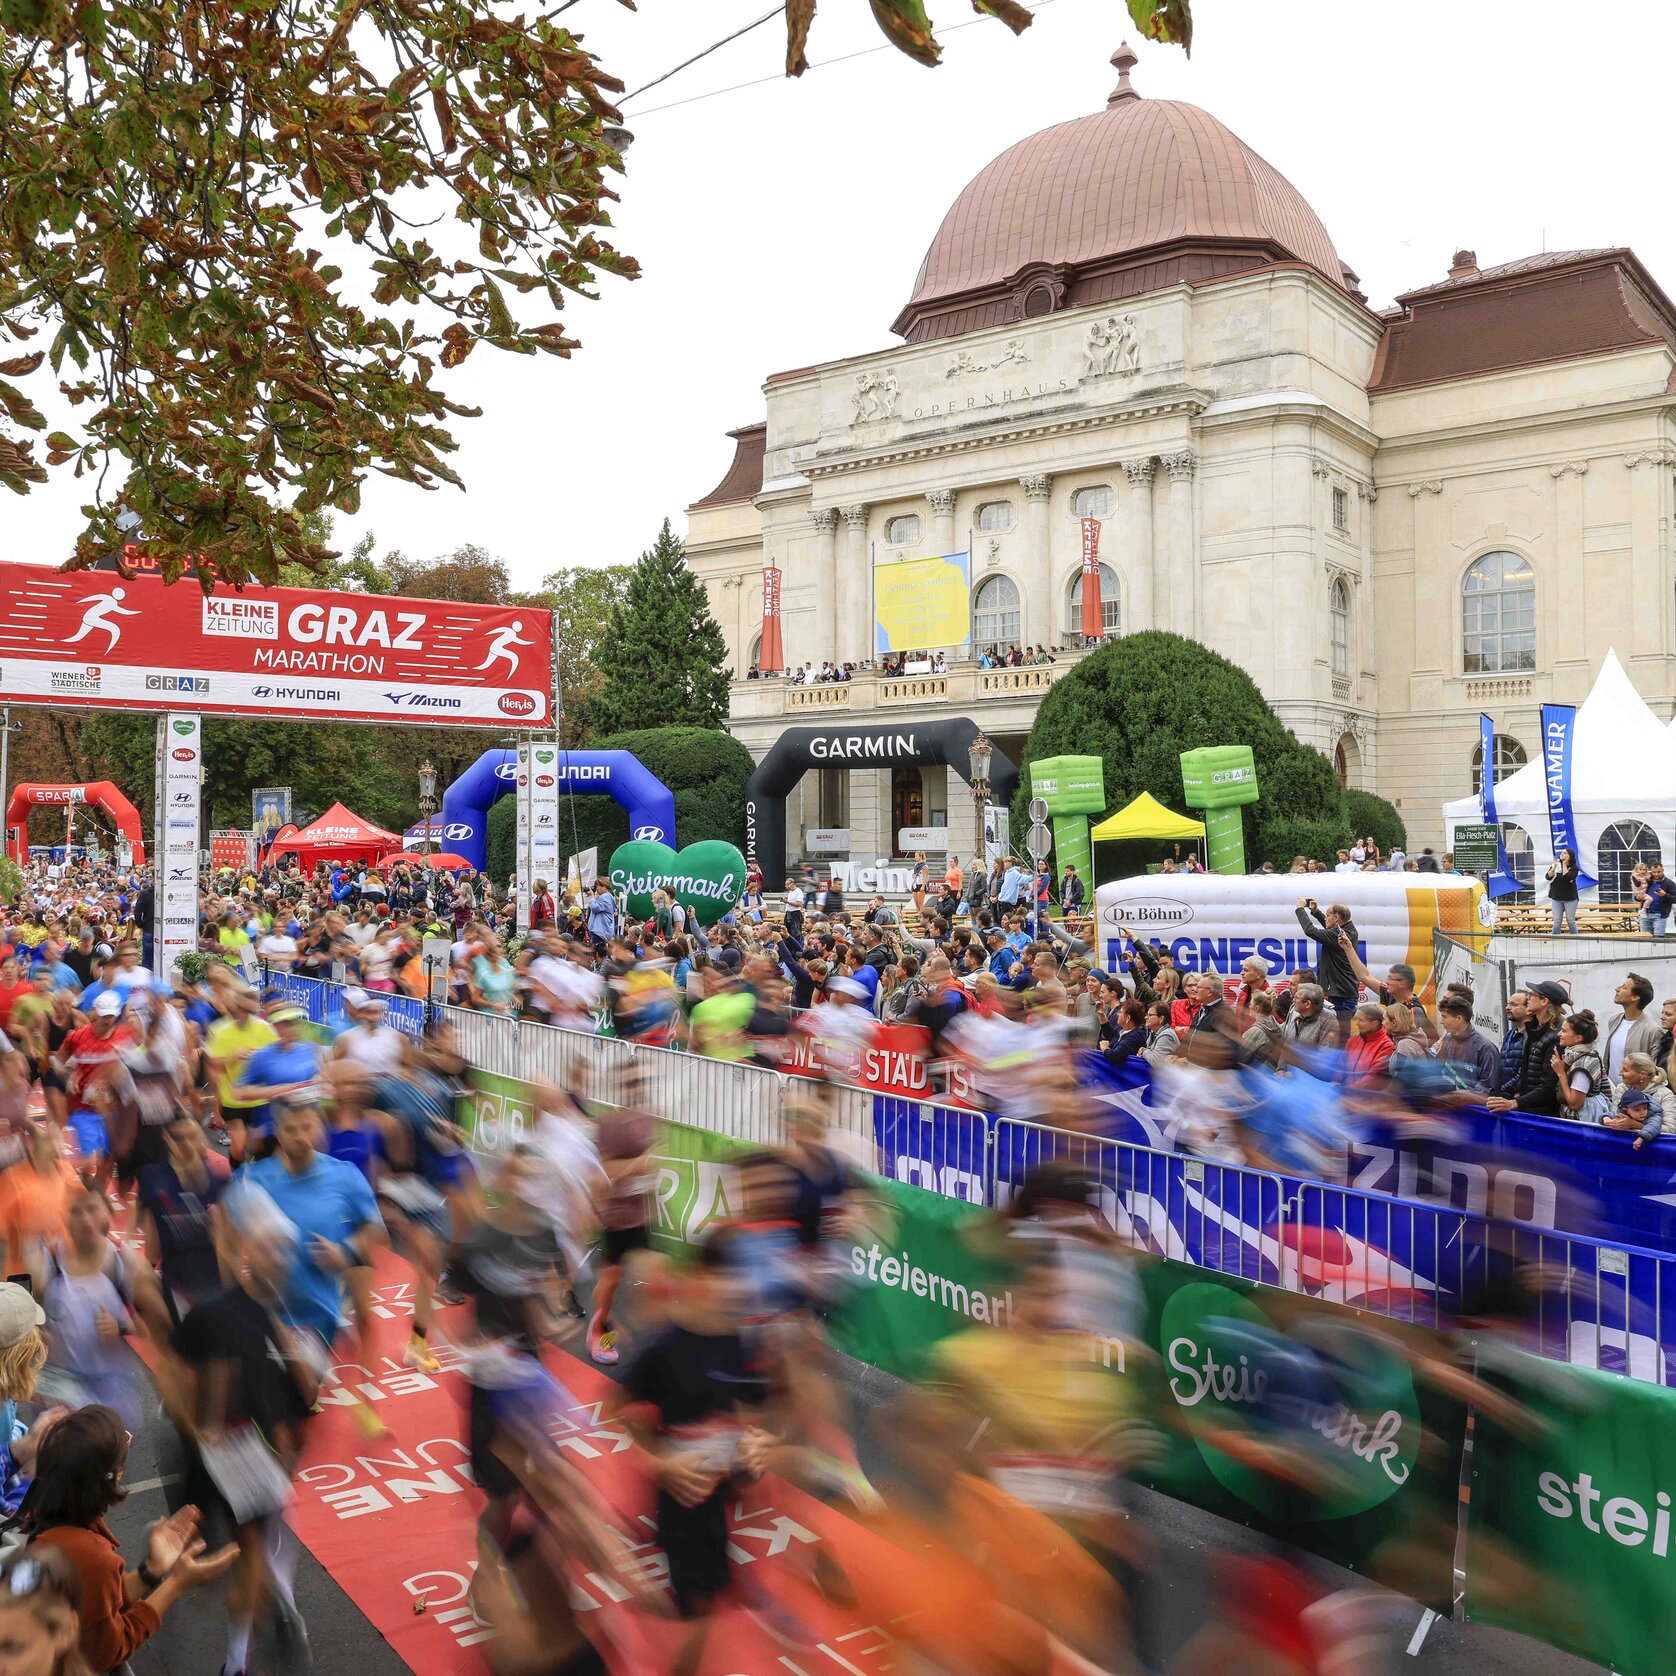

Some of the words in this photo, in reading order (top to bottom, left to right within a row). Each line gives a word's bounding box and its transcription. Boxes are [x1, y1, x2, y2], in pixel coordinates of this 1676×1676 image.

[914, 379, 1067, 418] OPERNHAUS
[207, 601, 274, 619] KLEINE
[206, 617, 274, 635] ZEITUNG
[287, 603, 427, 651] GRAZ
[253, 648, 385, 674] MARATHON
[51, 671, 86, 681] WIENER
[146, 675, 209, 692] GRAZ
[276, 688, 341, 701] HYUNDAI
[408, 694, 461, 708] MIZUNO
[501, 697, 533, 712] Hervis
[809, 734, 915, 759] GARMIN
[174, 751, 195, 759] Hervis
[558, 766, 610, 780] UNDAI
[1212, 767, 1251, 782] GRAZ
[36, 791, 70, 802] SPAR
[304, 832, 357, 841] ZEITUNG
[306, 827, 359, 836] KLEINE
[611, 869, 736, 903] Steiermark
[1113, 908, 1136, 921] Dr.
[1137, 907, 1183, 920] Böhm
[1107, 936, 1368, 977] MGNESIU
